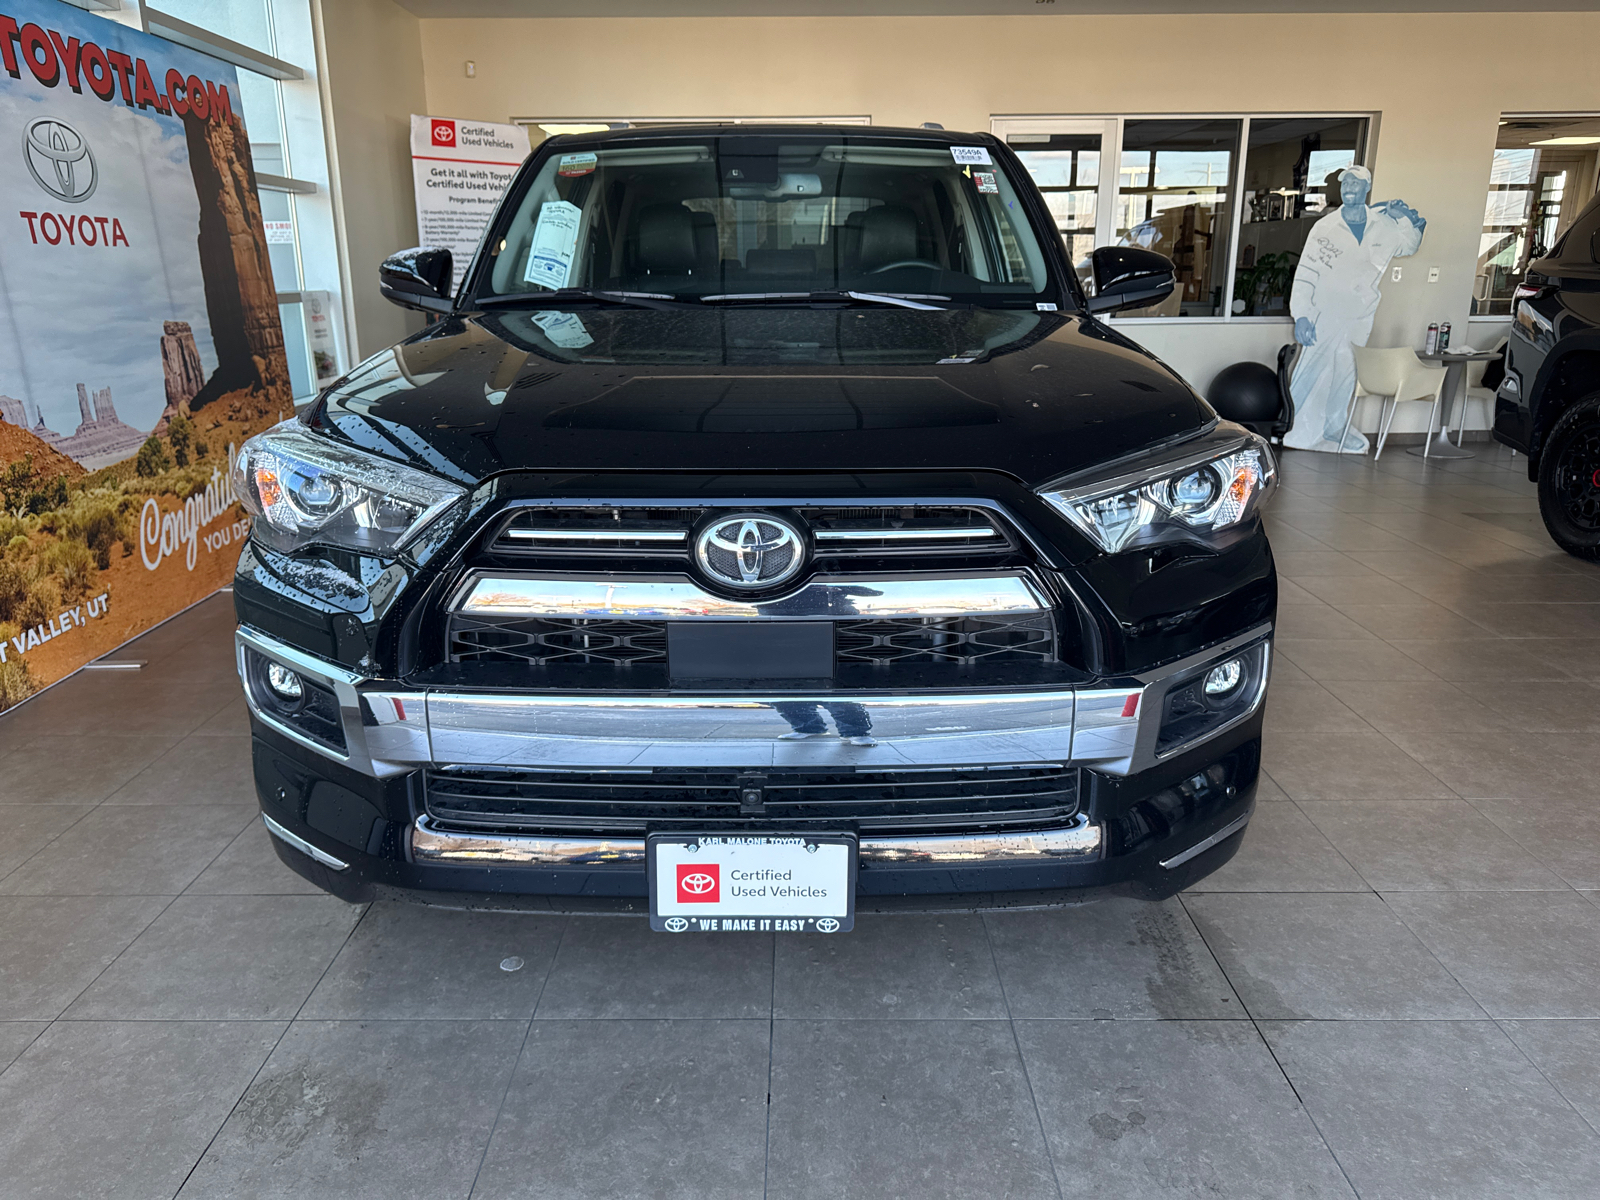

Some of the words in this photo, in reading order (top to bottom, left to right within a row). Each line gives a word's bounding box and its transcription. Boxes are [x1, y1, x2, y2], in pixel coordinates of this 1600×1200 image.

[0, 14, 234, 126] TOYOTA.COM
[461, 126, 495, 137] Certified
[462, 136, 482, 146] Used
[483, 138, 514, 149] Vehicles
[430, 168, 447, 177] Get
[448, 168, 455, 177] it
[457, 169, 468, 178] all
[469, 170, 489, 180] with
[489, 171, 513, 182] Toyot
[426, 179, 465, 189] Certified
[466, 181, 488, 191] Used
[489, 182, 508, 192] Vehi
[449, 195, 477, 205] Program
[478, 197, 501, 205] Benefi
[20, 211, 130, 247] TOYOTA
[203, 526, 231, 553] YOU
[232, 518, 251, 541] DE
[11, 606, 86, 655] VALLEY,
[86, 593, 108, 618] UT
[698, 837, 725, 846] KARL
[727, 837, 767, 846] MALONE
[769, 837, 806, 846] TOYOTA
[731, 869, 792, 881] Certified
[731, 886, 766, 897] Used
[770, 886, 827, 898] Vehicles
[699, 919, 718, 931] WE
[722, 919, 755, 931] MAKE
[760, 919, 771, 931] IT
[775, 919, 805, 931] EASY
